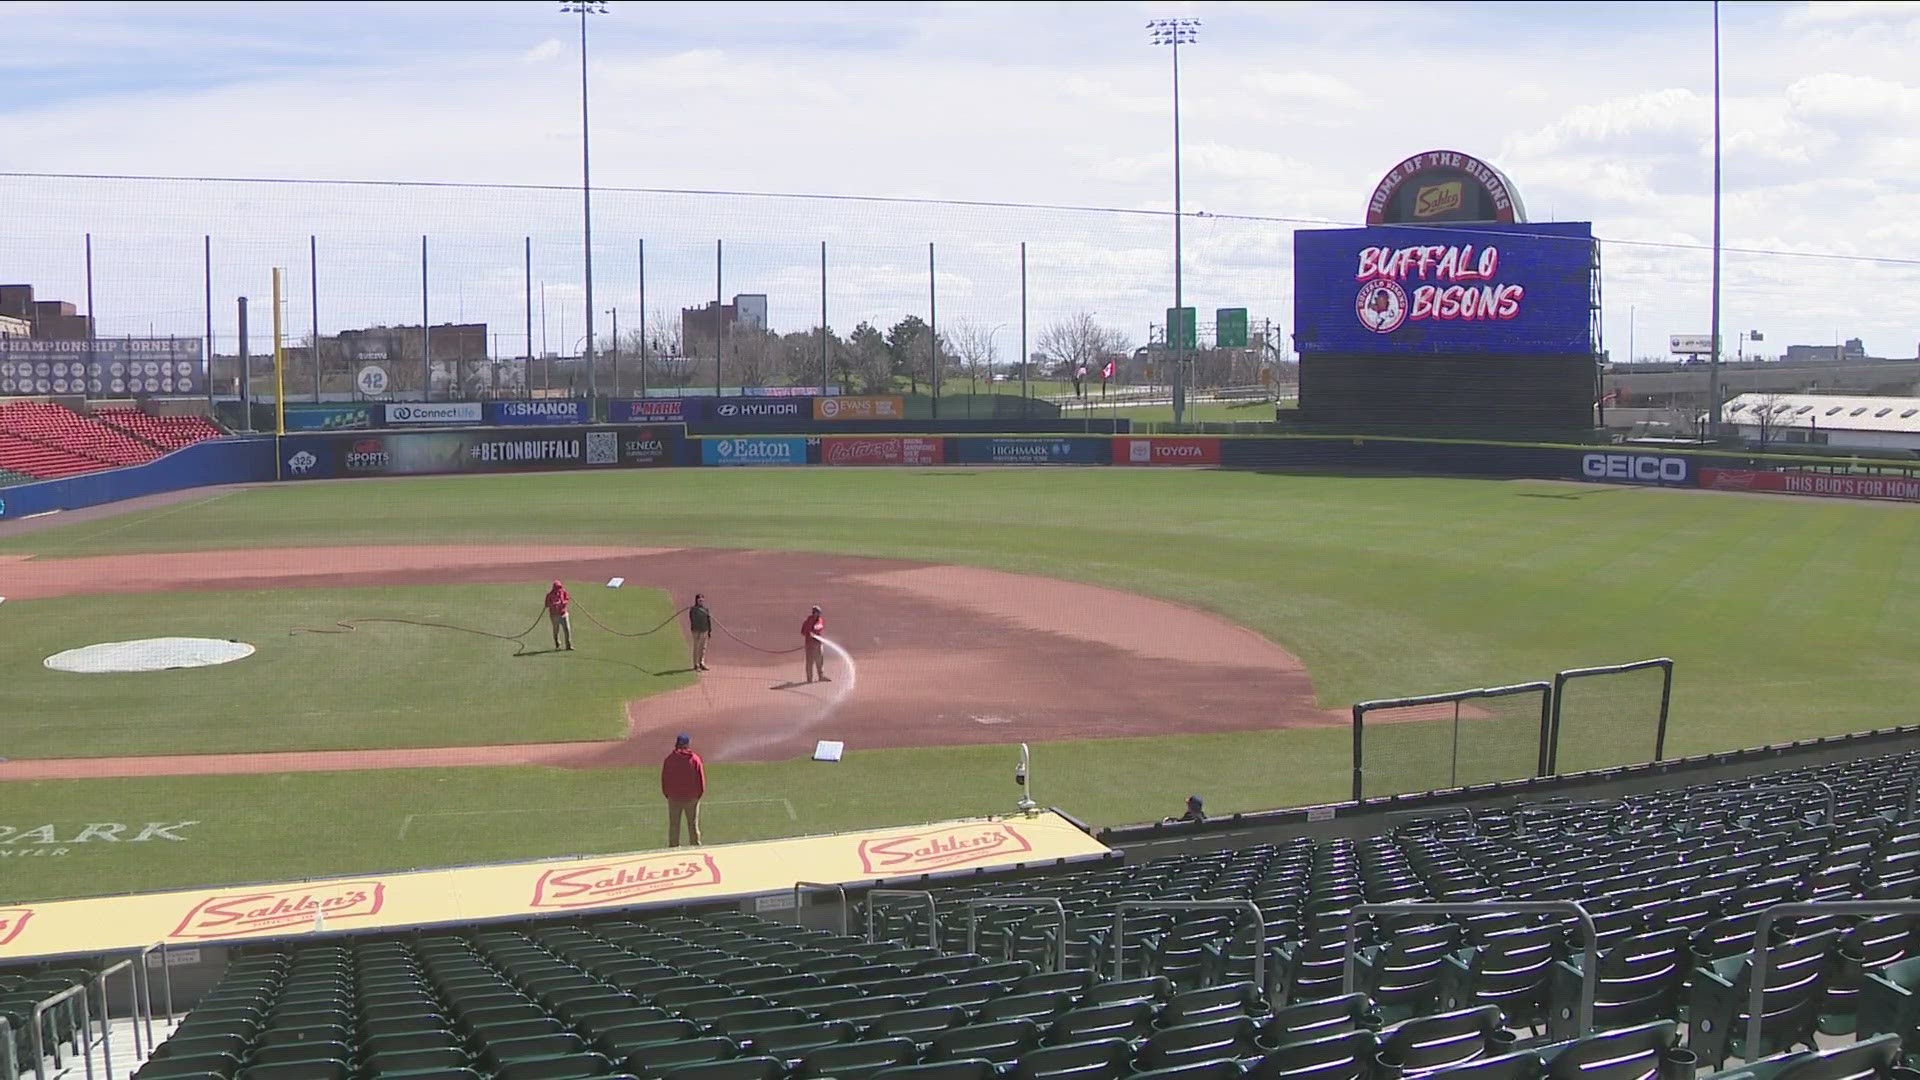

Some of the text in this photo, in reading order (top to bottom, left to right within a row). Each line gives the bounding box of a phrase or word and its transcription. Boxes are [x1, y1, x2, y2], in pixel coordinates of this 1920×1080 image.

[1370, 152, 1510, 214] HOME OF THE BISONS
[1355, 243, 1500, 283] BUFFALO
[1409, 283, 1524, 321] BISONS
[0, 340, 181, 353] CHAMPIONSHIP CORNER
[361, 372, 384, 389] 42
[518, 403, 578, 416] SHANOR
[741, 404, 798, 415] HYUNDAI
[840, 401, 872, 410] EVANS
[470, 439, 580, 461] #BETONBUFFALO
[625, 440, 664, 451] SENECA
[734, 439, 790, 457] Eaton
[992, 445, 1048, 456] HIGHMARK
[1154, 446, 1203, 456] TOYOTA
[293, 456, 312, 466] 325
[347, 451, 389, 462] SPORTS
[1582, 453, 1687, 481] GEICO
[1785, 476, 1920, 498] THIS BUD'S FOR HOM
[869, 831, 1010, 866] Sahlen's
[549, 862, 703, 898] Sahlen's
[196, 890, 368, 928] Sahlen's
